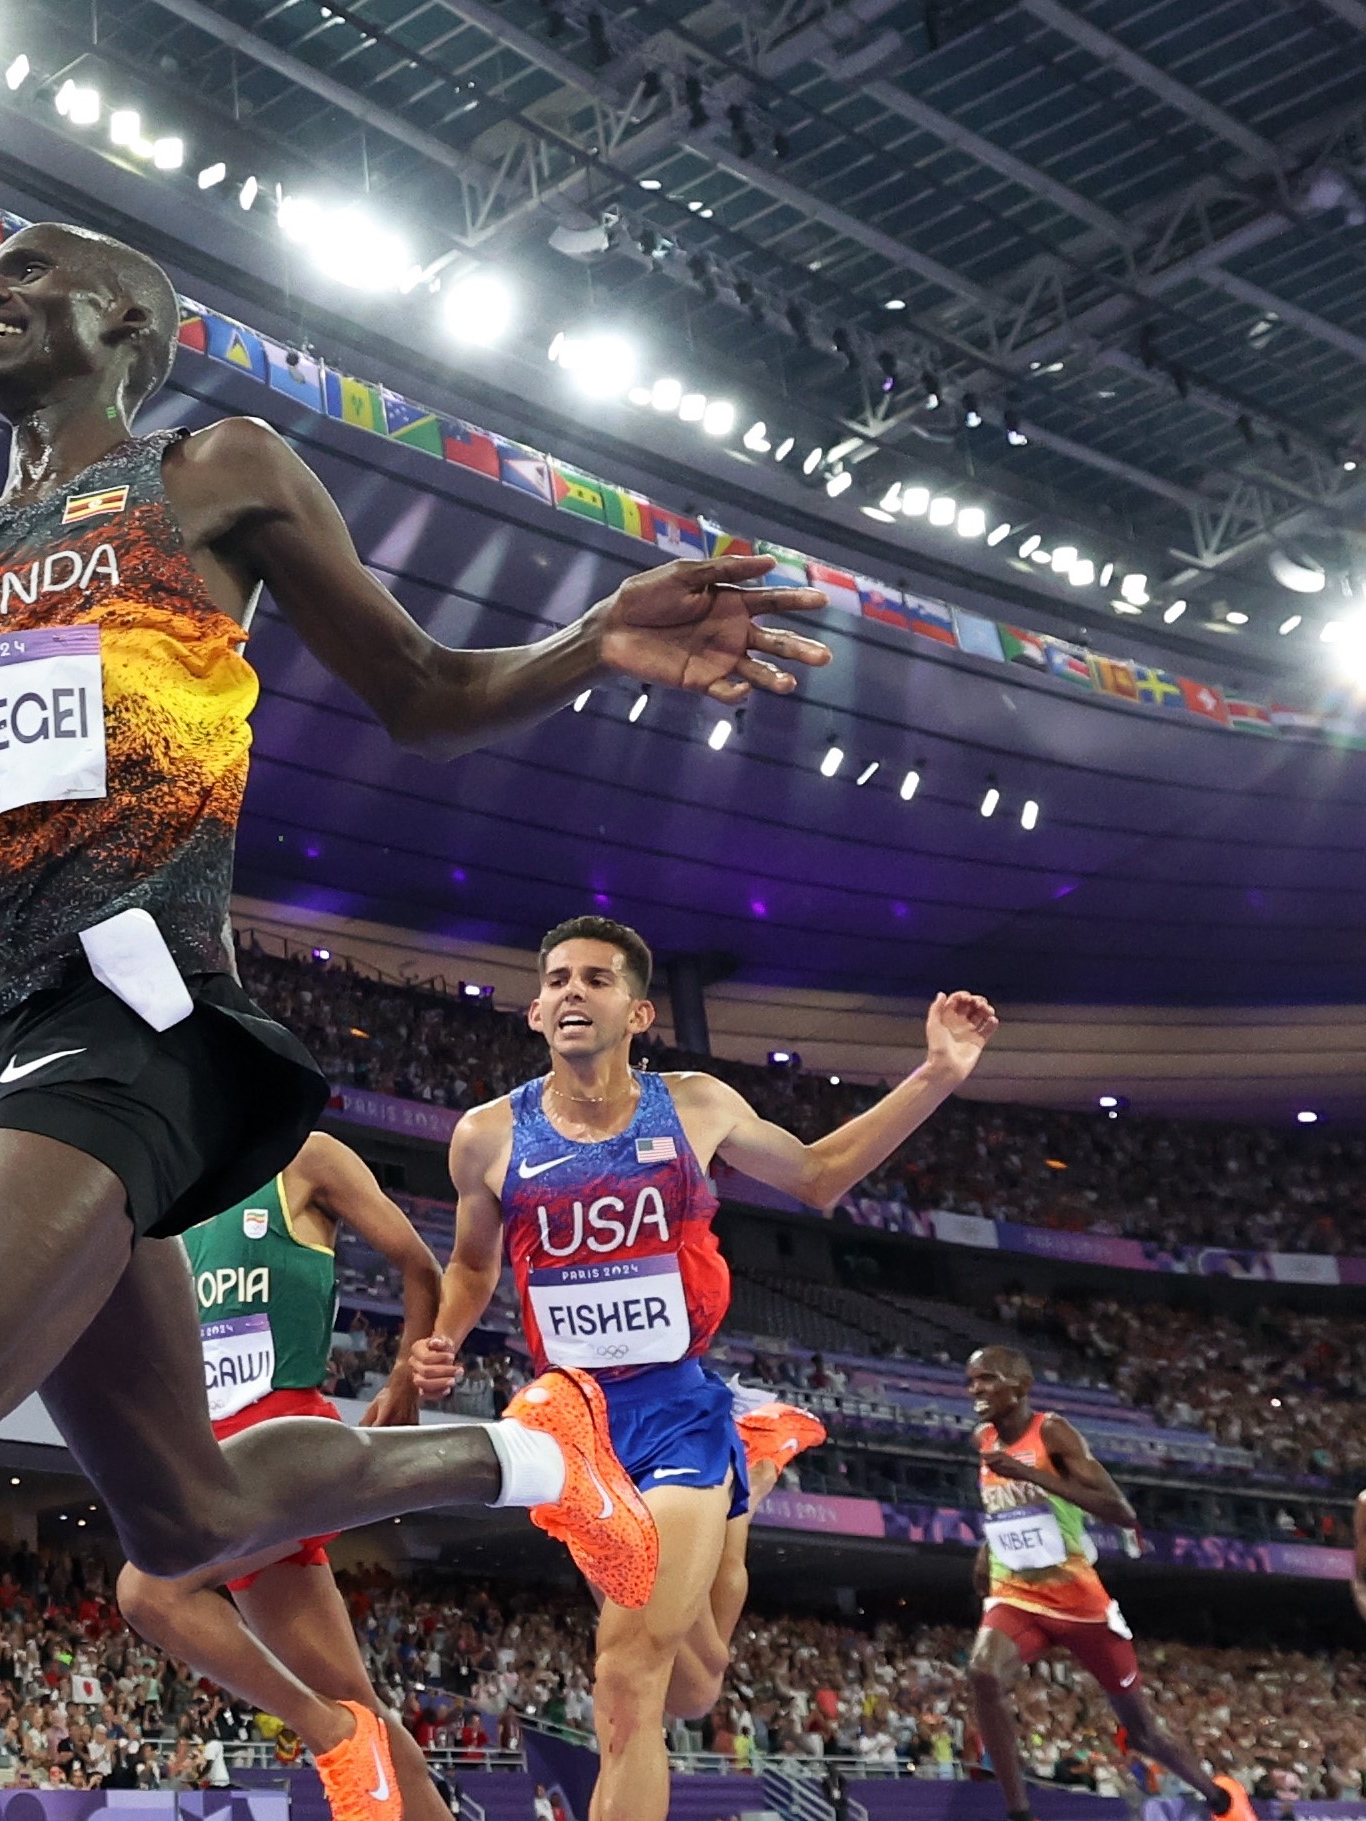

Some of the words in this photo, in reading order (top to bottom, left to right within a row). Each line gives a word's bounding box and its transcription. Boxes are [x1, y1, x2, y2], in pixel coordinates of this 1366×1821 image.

[538, 1186, 670, 1257] USA
[192, 1266, 269, 1308] OPIA
[562, 1268, 600, 1281] PARIS
[603, 1264, 639, 1277] 2024
[549, 1297, 671, 1336] FISHER
[204, 1350, 270, 1390] GAWI
[998, 1527, 1044, 1551] KIBET
